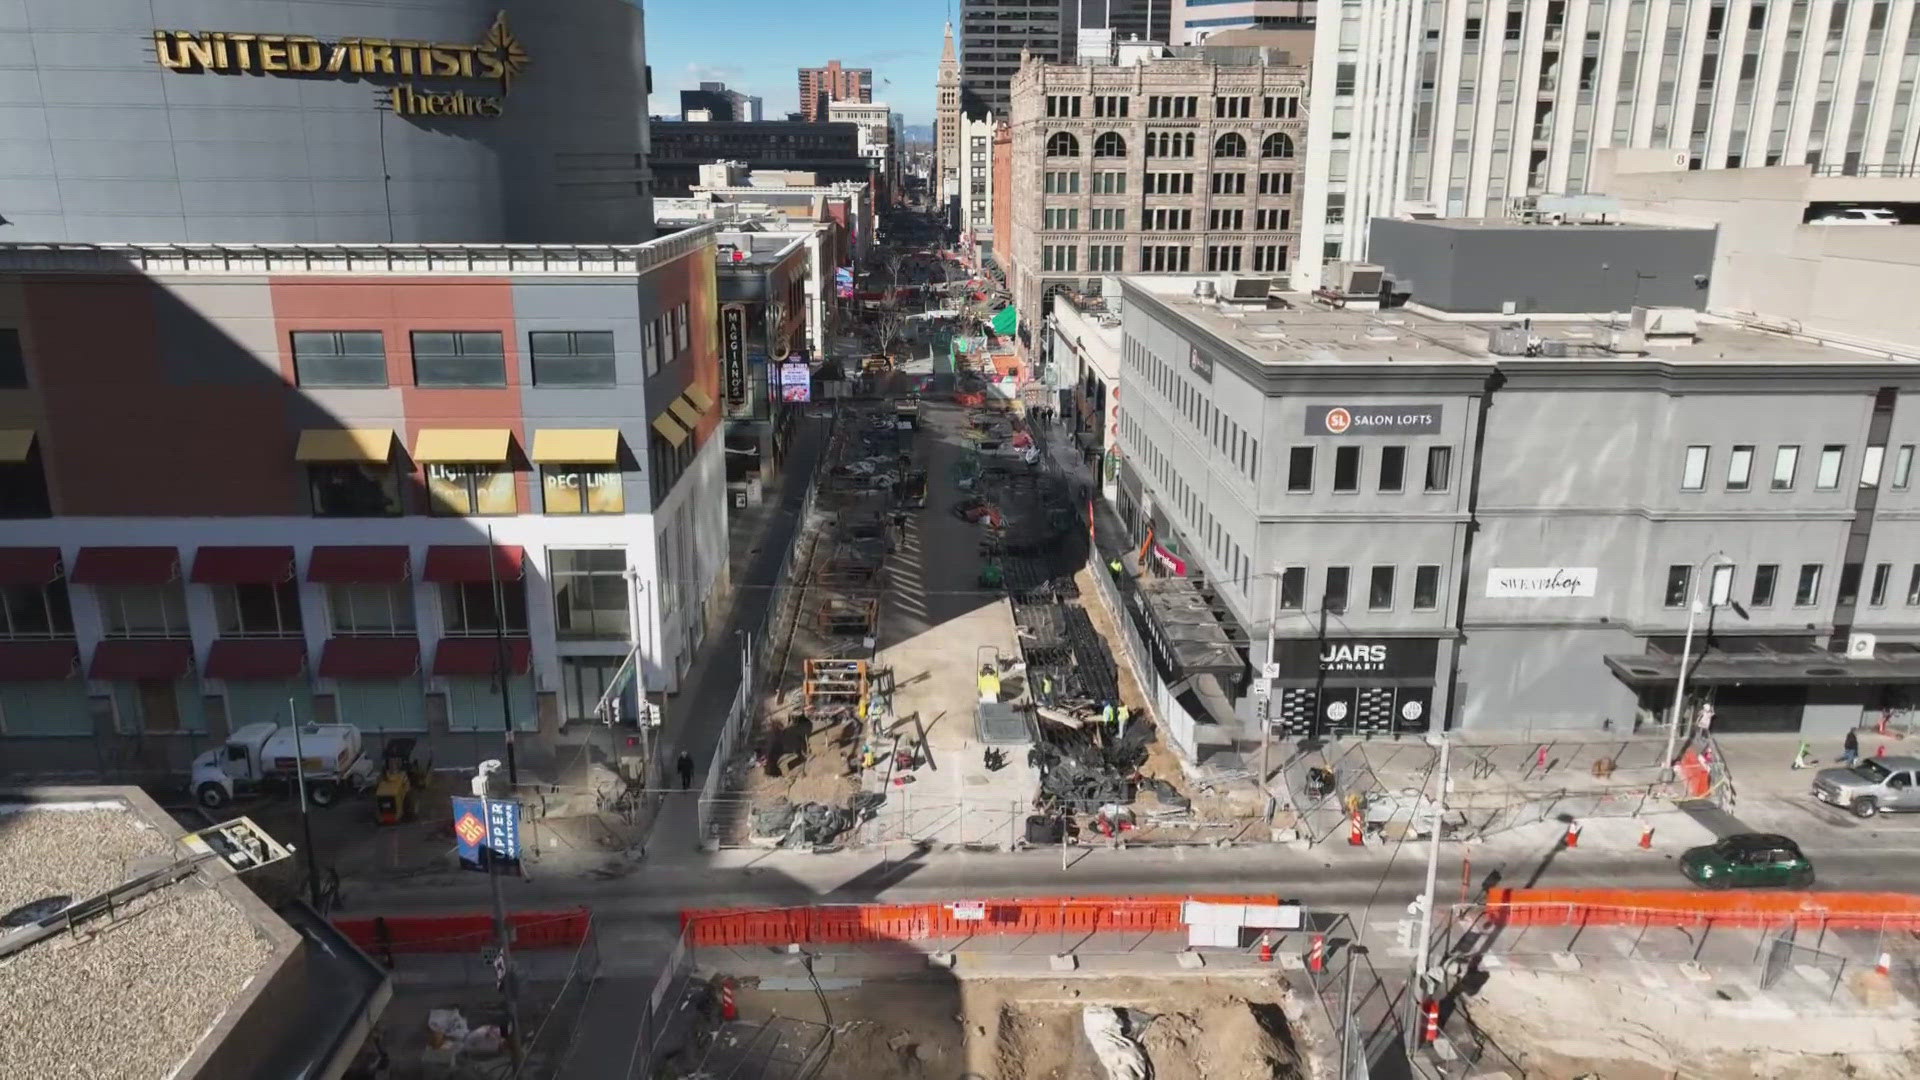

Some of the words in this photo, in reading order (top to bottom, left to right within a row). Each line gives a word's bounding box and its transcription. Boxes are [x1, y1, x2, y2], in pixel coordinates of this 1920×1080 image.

[154, 30, 321, 71] UNITED
[326, 36, 507, 79] ARTISTS
[391, 82, 502, 117] Theatres
[1354, 414, 1393, 426] SALON
[1397, 414, 1432, 425] LOFTS
[1320, 644, 1387, 662] JARS
[1319, 662, 1385, 671] CANNABIS
